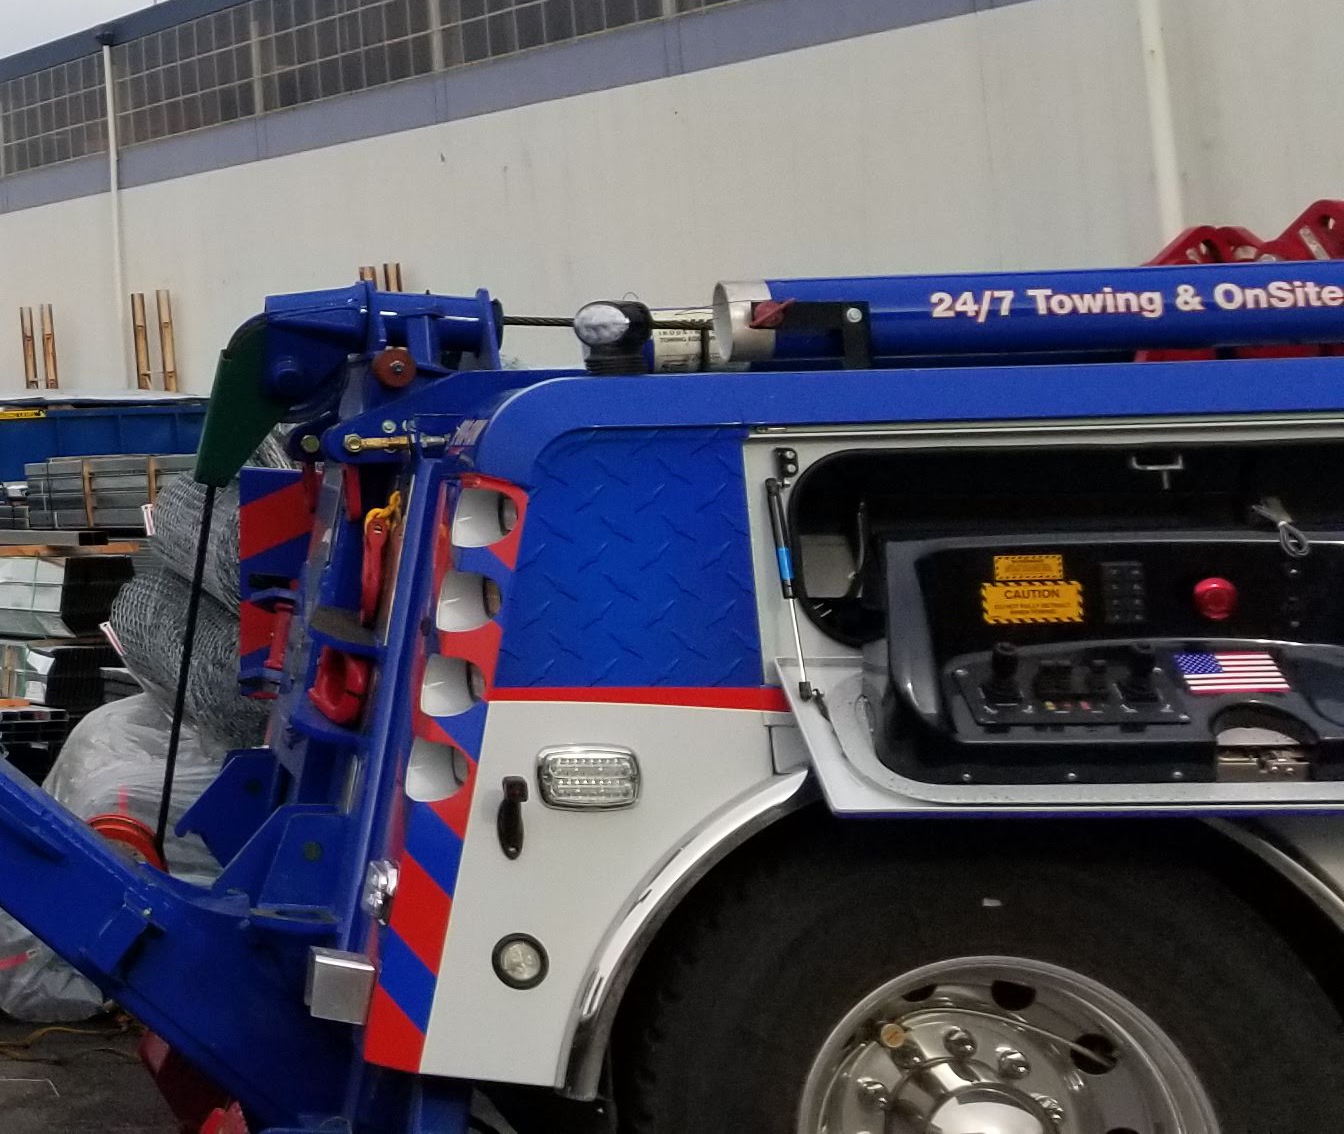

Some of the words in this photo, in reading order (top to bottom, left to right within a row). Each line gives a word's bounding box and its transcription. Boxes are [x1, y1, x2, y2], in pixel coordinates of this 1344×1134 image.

[929, 289, 1015, 323] 24/7
[1026, 287, 1163, 318] Towing
[1174, 284, 1205, 312] &
[1213, 280, 1344, 310] OnSite
[1004, 589, 1061, 600] CAUTION
